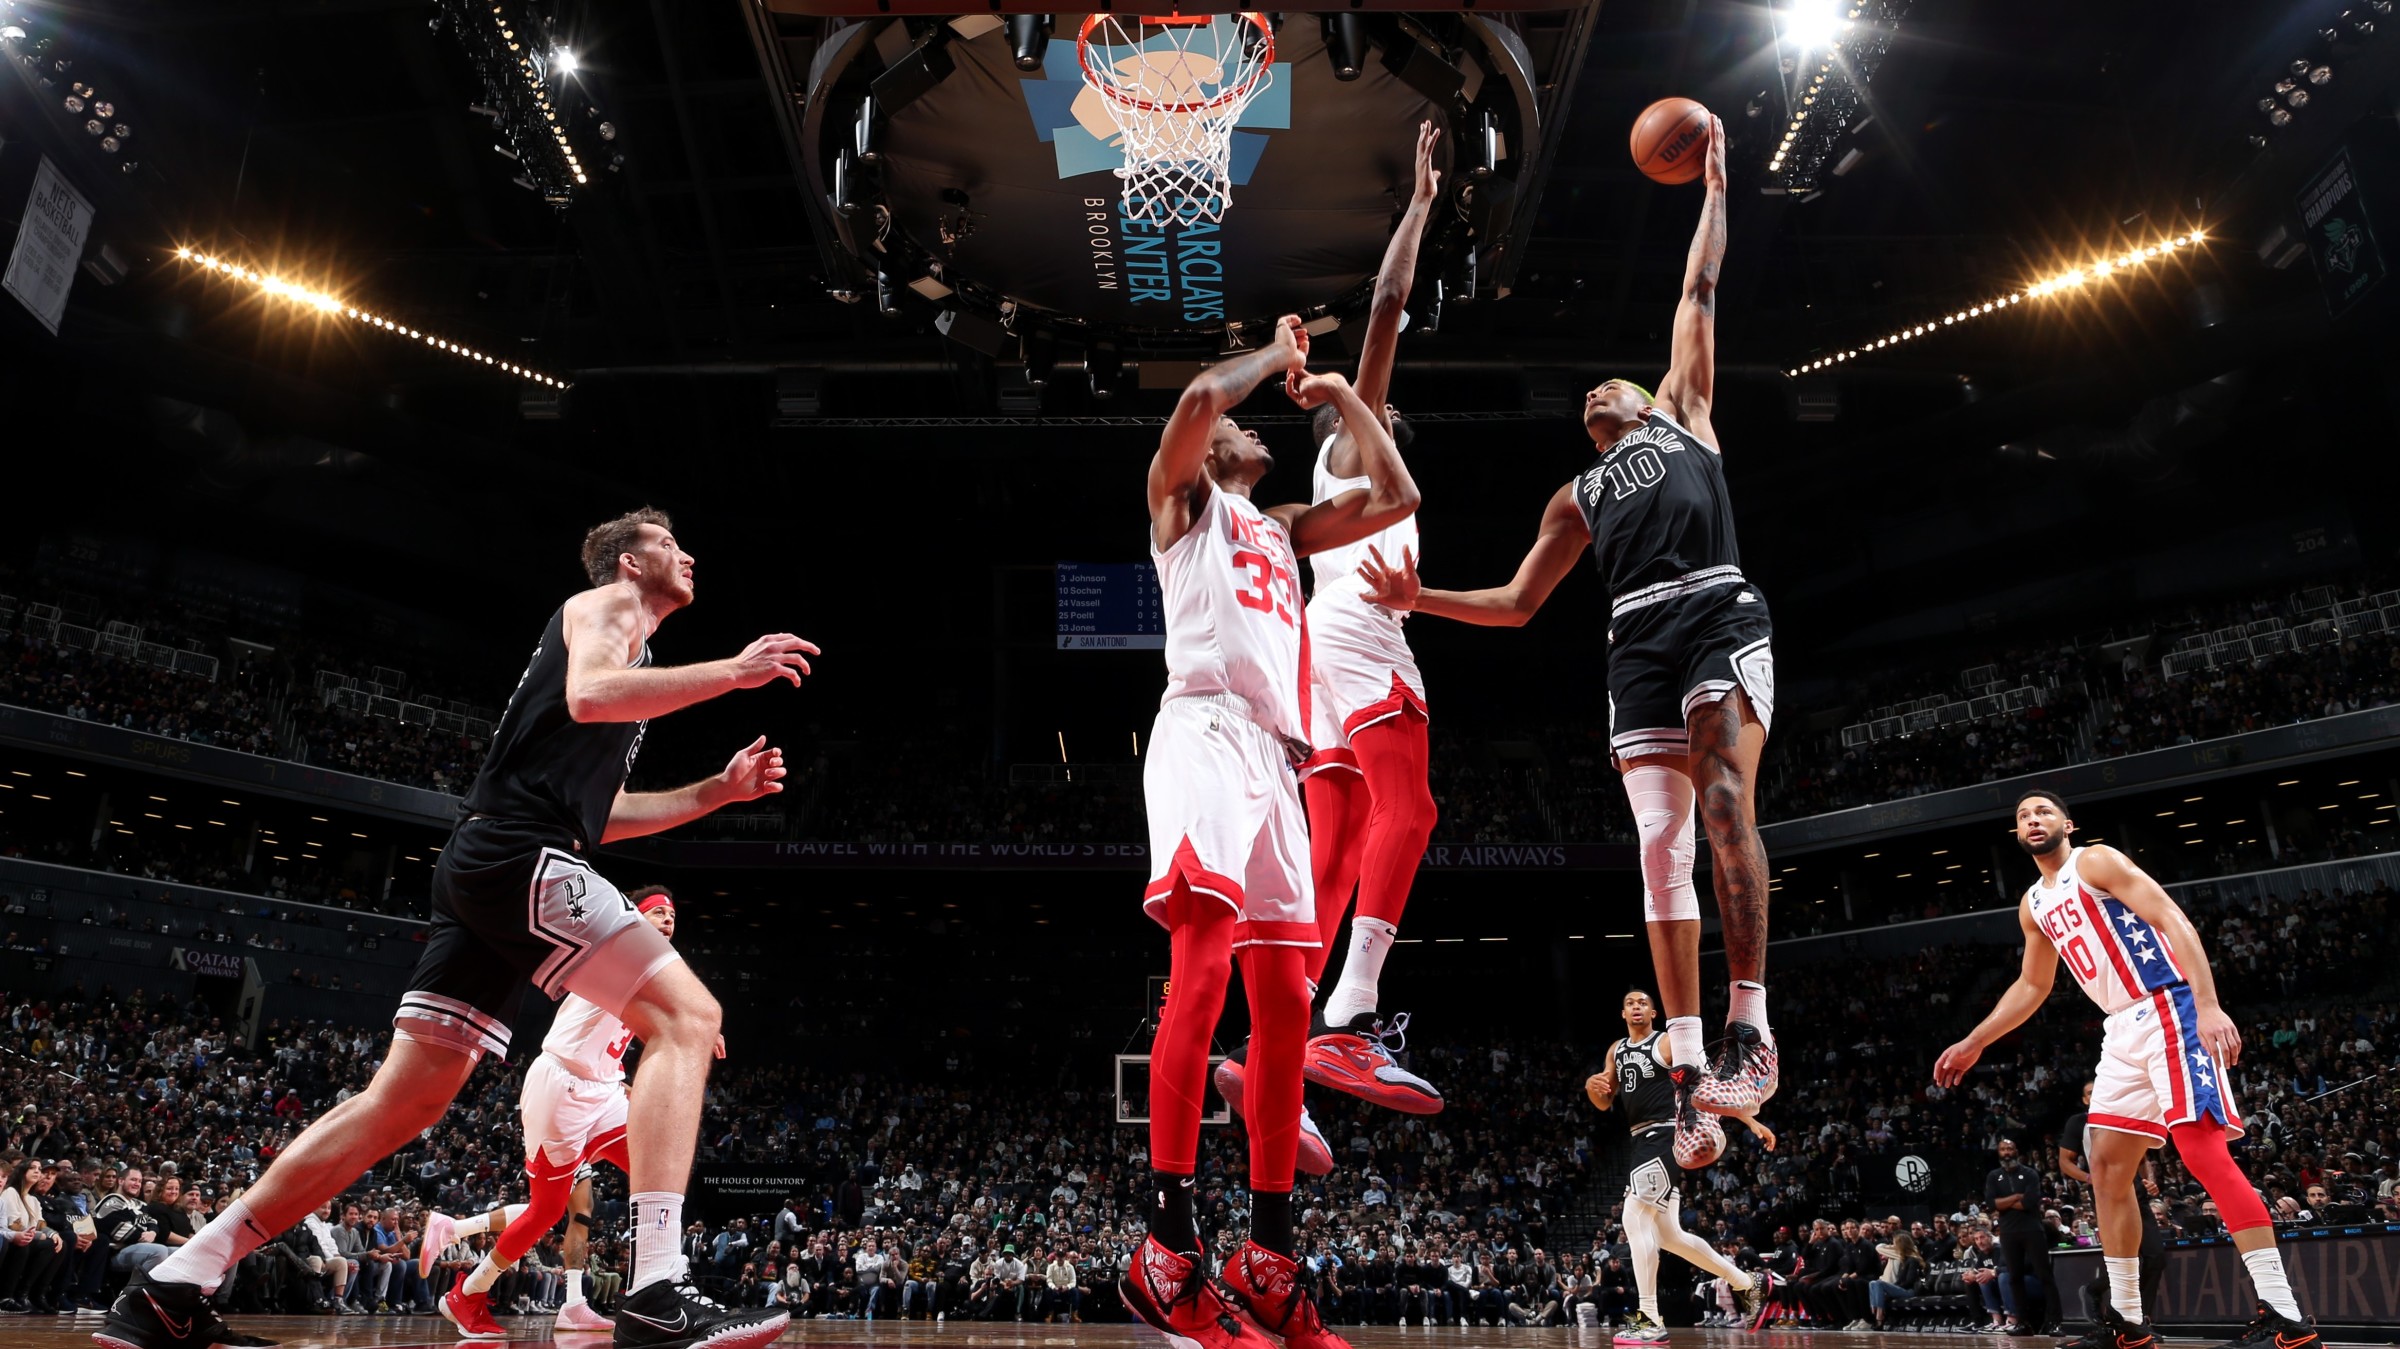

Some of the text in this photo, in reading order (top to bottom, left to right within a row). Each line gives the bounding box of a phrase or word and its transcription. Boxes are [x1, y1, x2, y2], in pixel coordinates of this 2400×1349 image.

[1659, 120, 1709, 163] Wilson
[35, 191, 79, 247] BASKETBALL
[51, 181, 76, 221] NETS
[2304, 172, 2352, 229] CHAMPIONS
[1084, 198, 1118, 290] BROOKLYN
[1117, 195, 1171, 303] CENTER
[1174, 196, 1225, 322] BARCLAYS
[1605, 447, 1666, 500] 10
[2296, 535, 2327, 553] 204
[1232, 549, 1294, 631] 33
[1080, 637, 1128, 647] SAN ANTONIO
[131, 738, 192, 764] SPURS
[2101, 765, 2117, 784] 8
[1104, 844, 1146, 856] BES
[1458, 846, 1566, 866] AIRWAYS
[2039, 898, 2082, 942] NETS
[187, 950, 240, 969] QATAR
[197, 965, 239, 978] AIRWAYS
[2061, 934, 2097, 985] 10
[1624, 1068, 1637, 1093] 3
[703, 1177, 806, 1185] THE HOUSE OF SUNTORY
[2156, 1250, 2259, 1317] ATAR
